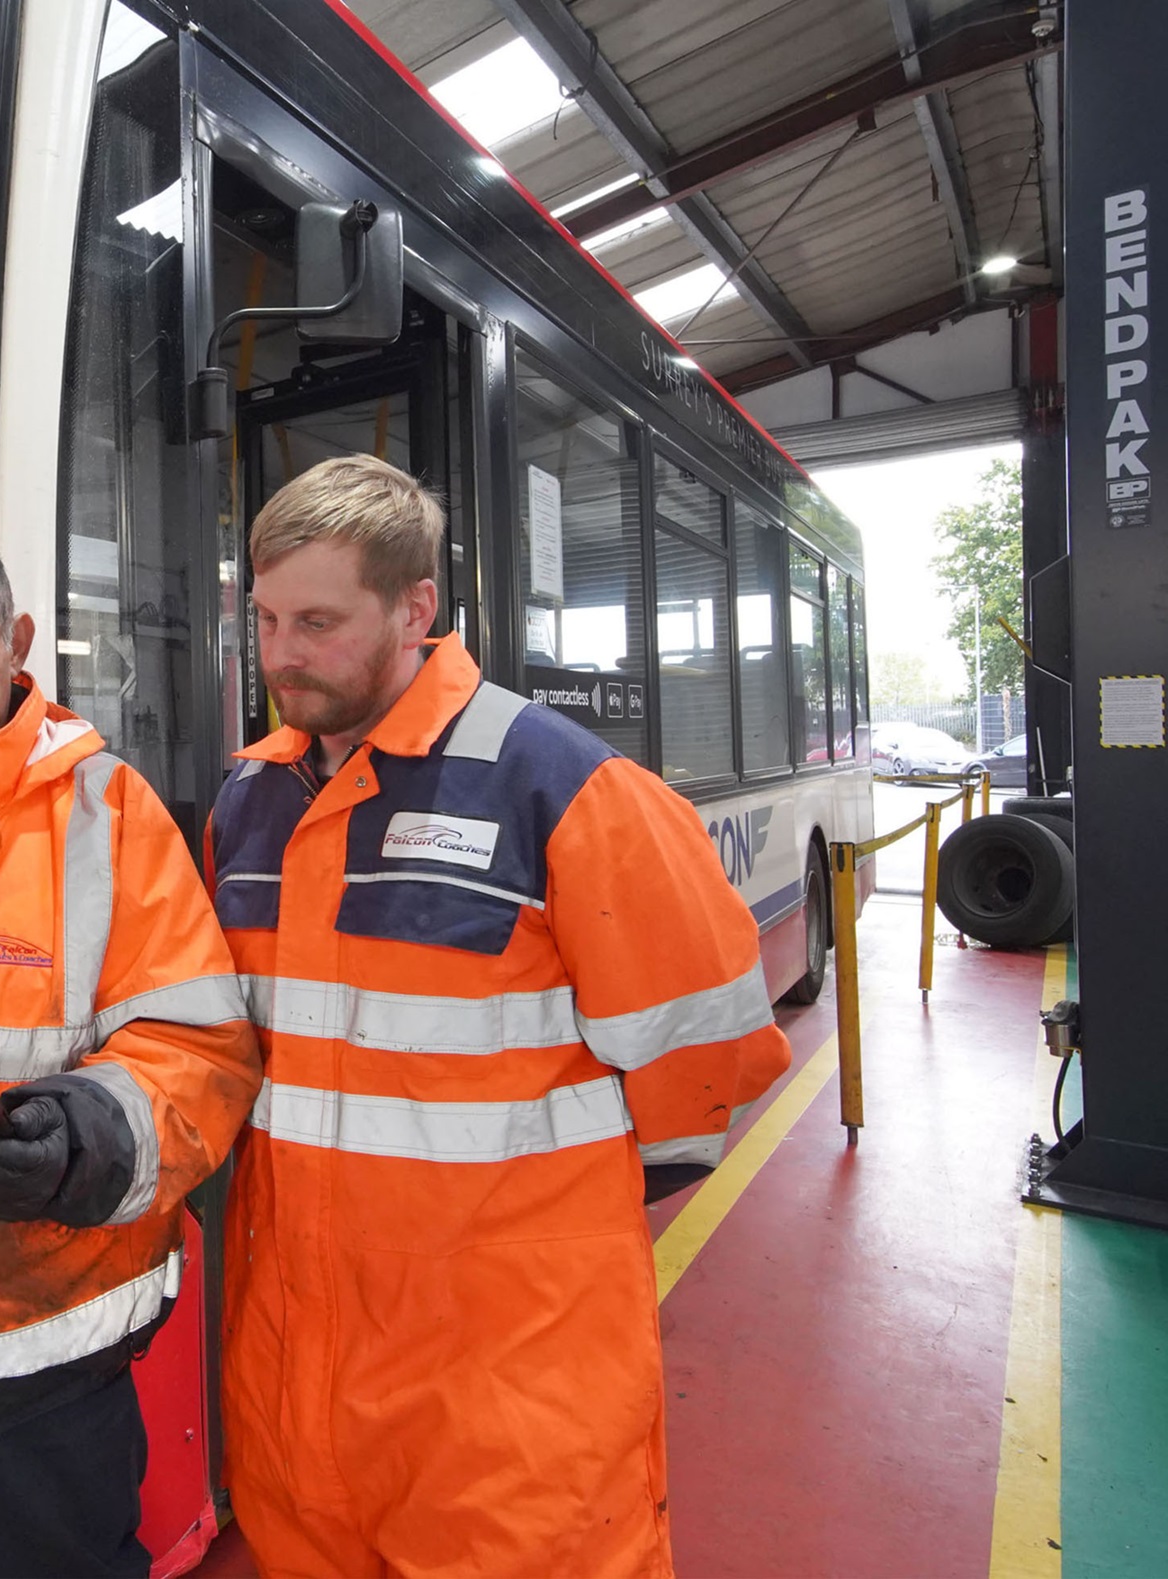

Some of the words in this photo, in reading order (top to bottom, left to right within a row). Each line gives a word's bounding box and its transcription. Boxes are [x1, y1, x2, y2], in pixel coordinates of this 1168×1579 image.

[1104, 189, 1150, 479] BENDPAK
[1110, 481, 1147, 499] BP
[533, 689, 548, 706] pay
[549, 685, 590, 706] contactless
